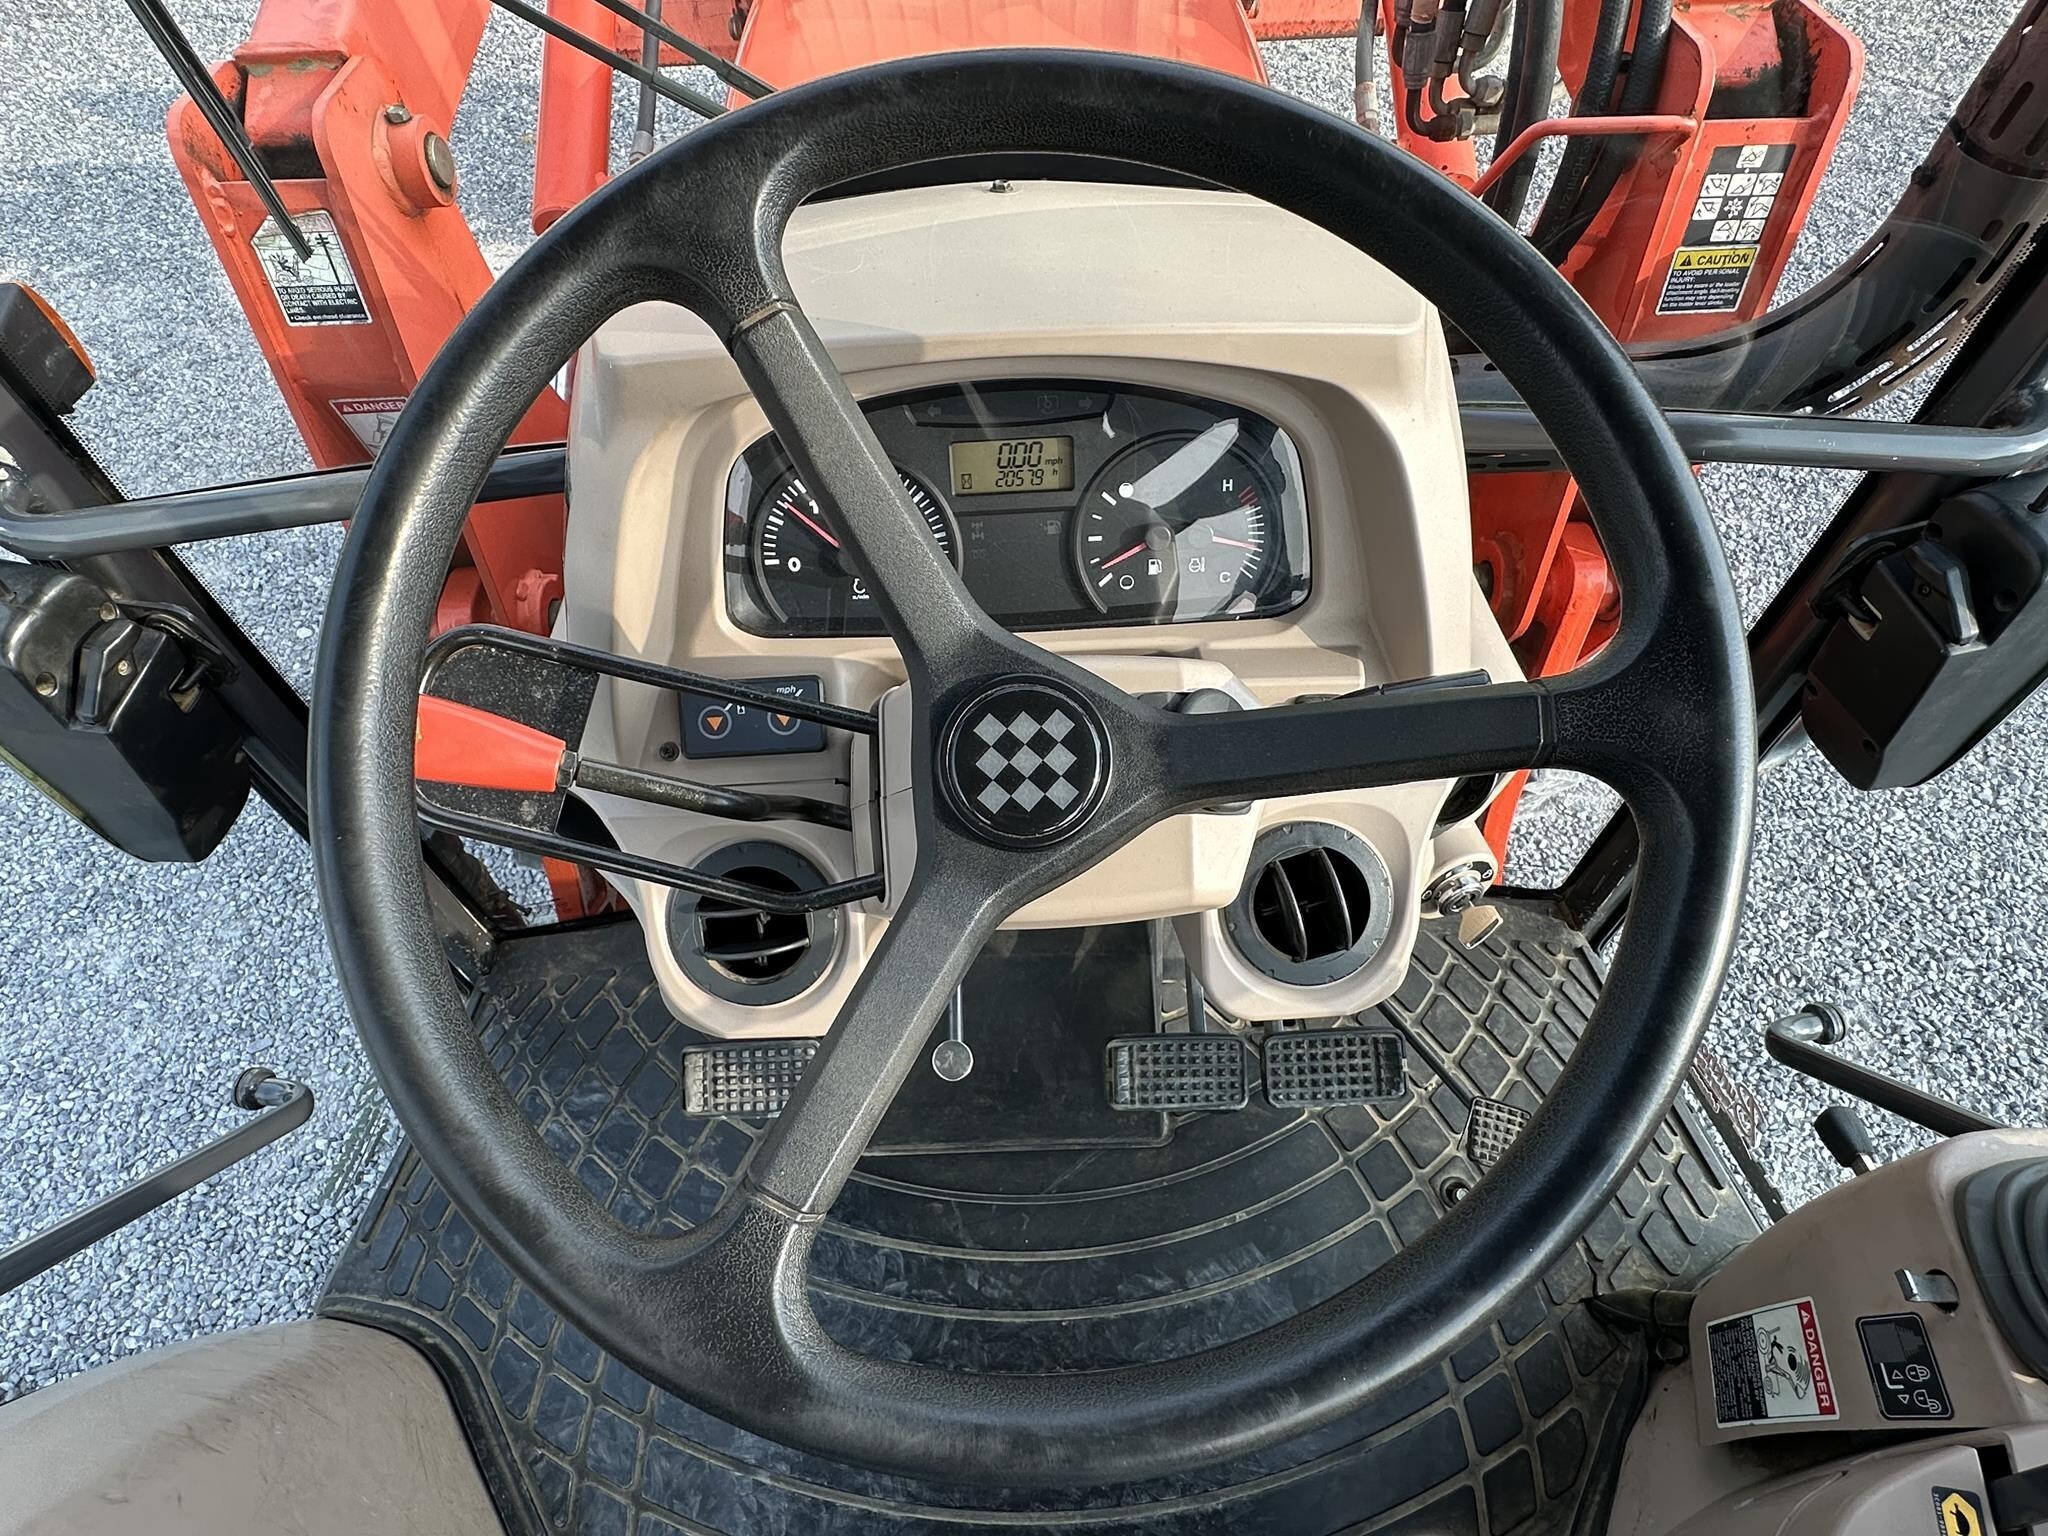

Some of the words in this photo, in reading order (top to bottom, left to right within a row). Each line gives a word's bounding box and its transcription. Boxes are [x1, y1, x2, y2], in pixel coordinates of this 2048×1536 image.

[1697, 253, 1749, 266] CAUTION
[1683, 269, 1703, 277] AVOID
[277, 287, 287, 295] TO
[306, 285, 334, 293] SERIOUS
[328, 298, 358, 306] ELECTRIC
[353, 401, 404, 412] DANGER
[996, 441, 1044, 469] 0.00
[1045, 457, 1063, 467] mph
[1052, 468, 1058, 476] h
[1222, 479, 1233, 492] H
[787, 556, 801, 573] 0
[1219, 571, 1231, 583] C
[776, 685, 796, 694] mph
[1805, 1328, 1831, 1407] DANGER
